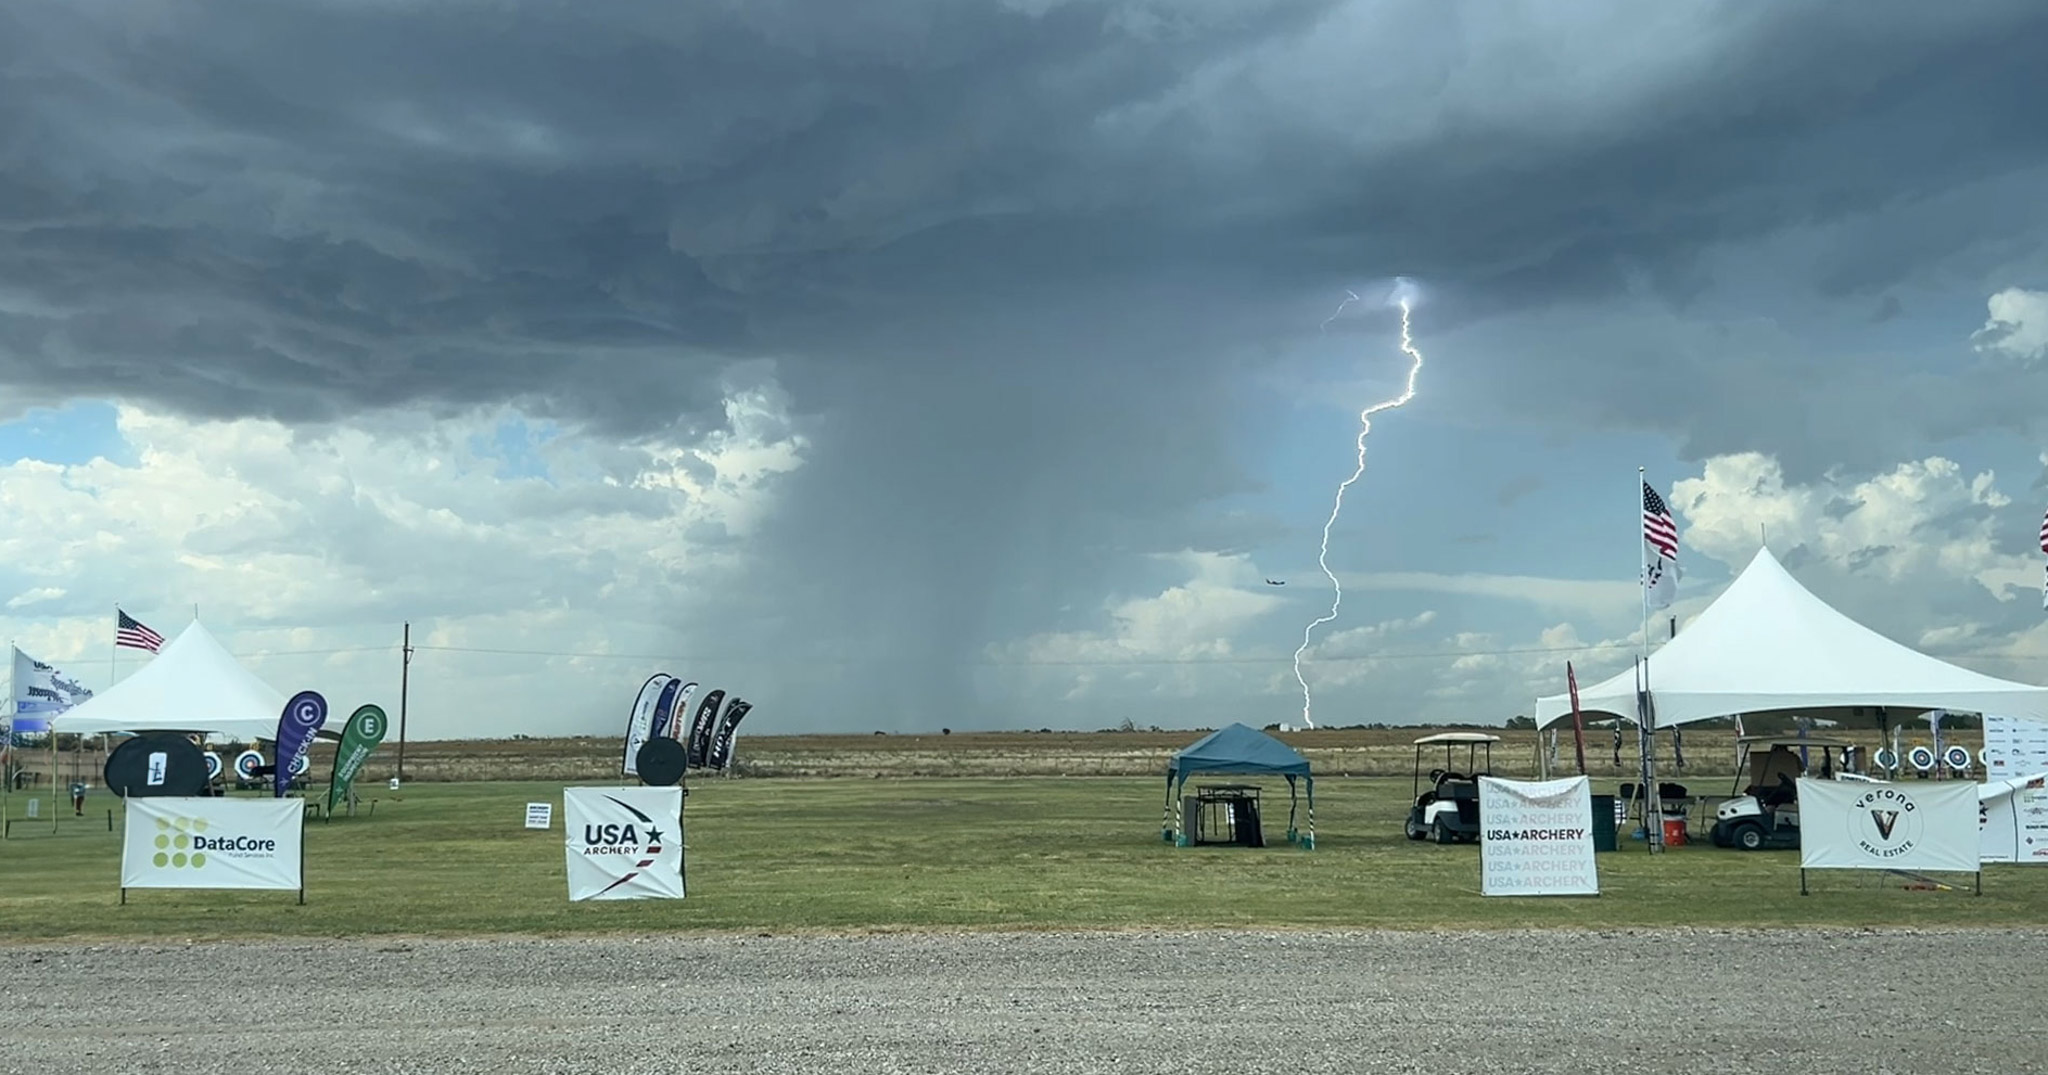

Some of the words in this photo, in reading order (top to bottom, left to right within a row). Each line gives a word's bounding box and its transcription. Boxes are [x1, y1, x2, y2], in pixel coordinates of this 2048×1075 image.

[300, 705, 314, 720] C
[365, 718, 375, 733] E
[287, 726, 318, 773] CHECK-IN
[1486, 798, 1509, 808] USA
[1519, 798, 1581, 808] ARCHERY
[1856, 790, 1915, 812] verona
[1487, 814, 1510, 824] USA
[1519, 814, 1582, 824] ARCHERY
[1870, 810, 1899, 840] V
[585, 824, 638, 845] USA
[1488, 830, 1511, 840] USA
[1520, 829, 1584, 840] ARCHERY
[194, 836, 275, 851] DataCore
[584, 846, 638, 855] ARCHERY
[1488, 846, 1512, 856] USA
[1521, 845, 1585, 855] ARCHERY
[1859, 840, 1880, 857] REAL
[1883, 840, 1914, 858] ESTATE
[1488, 861, 1513, 871] USA
[1523, 860, 1586, 871] ARCHERY
[1489, 877, 1513, 887] USA
[1523, 876, 1588, 887] ARCHERY
